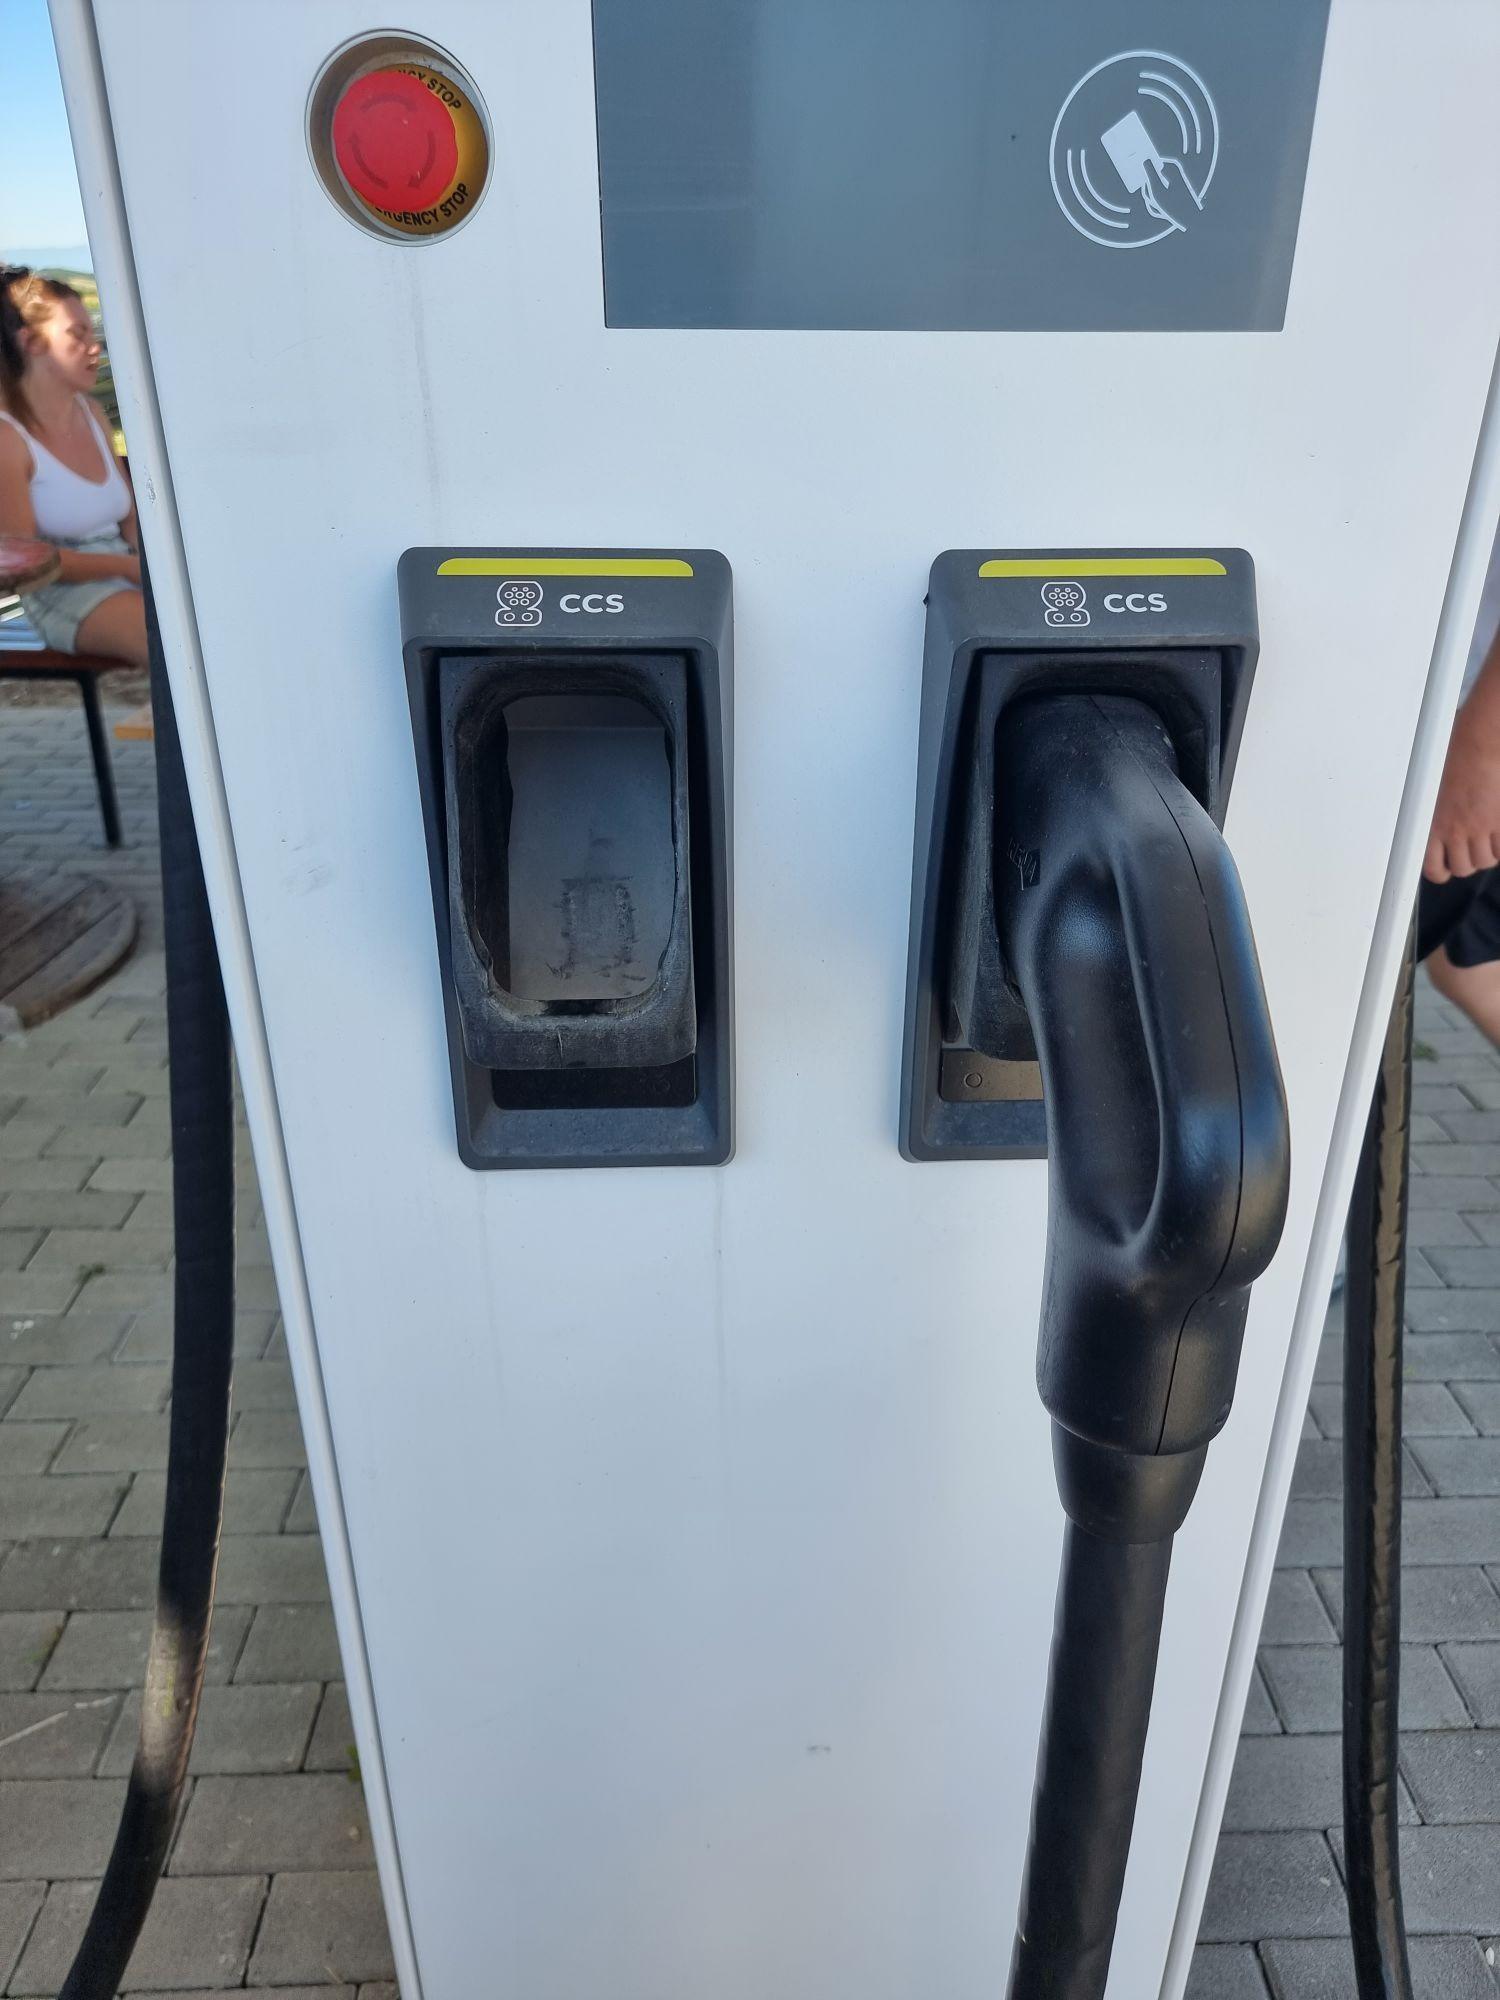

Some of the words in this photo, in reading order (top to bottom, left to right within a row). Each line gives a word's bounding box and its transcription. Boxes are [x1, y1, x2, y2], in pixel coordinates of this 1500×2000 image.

[427, 78, 462, 109] STOP
[375, 207, 439, 226] GENCY
[440, 183, 468, 217] STOP
[559, 594, 625, 614] CCS
[1103, 593, 1168, 613] CCS
